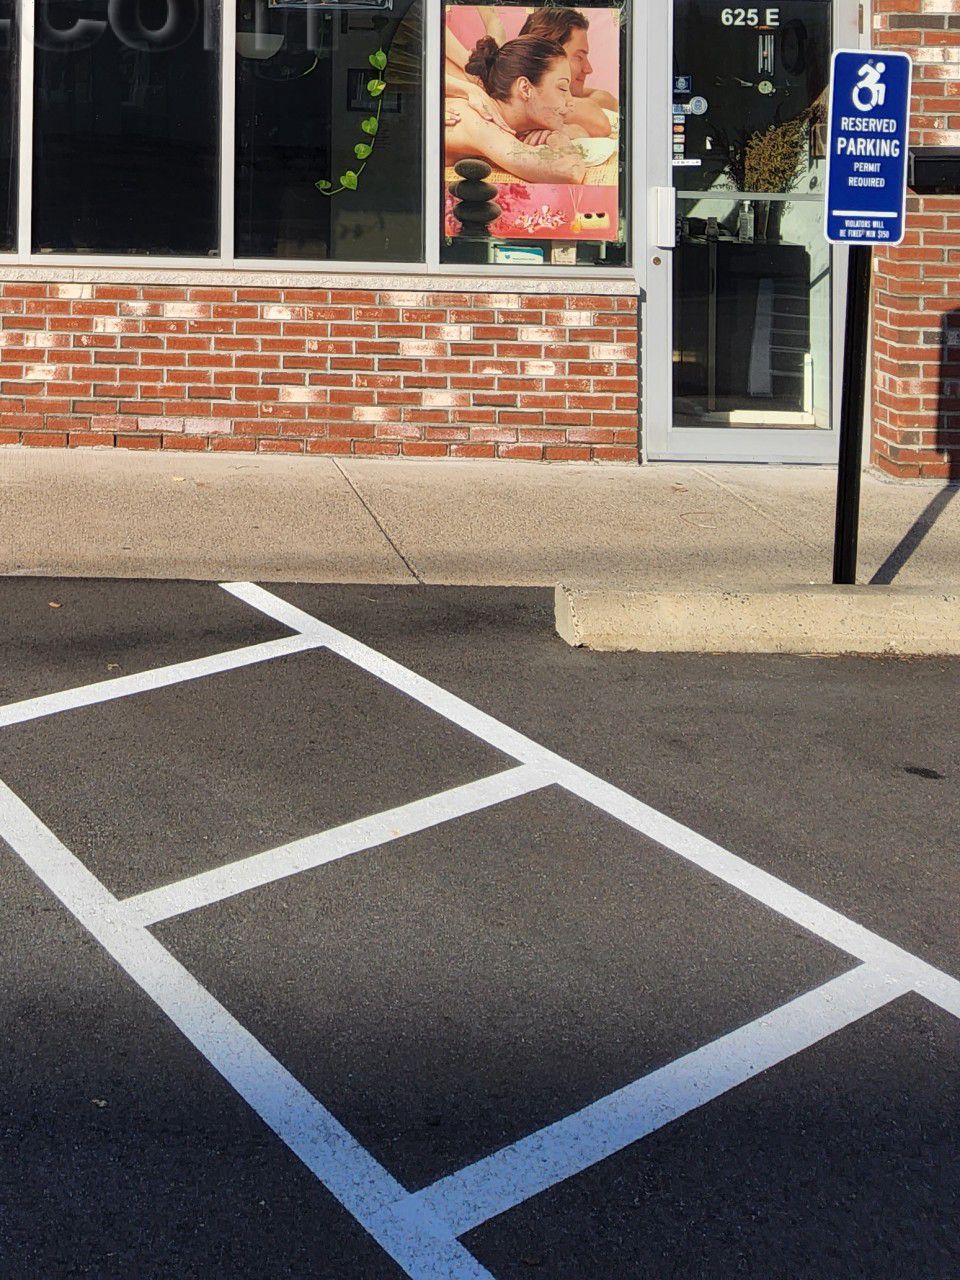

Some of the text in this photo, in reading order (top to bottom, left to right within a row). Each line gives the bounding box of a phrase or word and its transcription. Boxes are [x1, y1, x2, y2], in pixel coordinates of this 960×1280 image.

[721, 8, 780, 26] 625 E
[841, 117, 897, 133] RESERVED
[837, 137, 900, 157] PARKING
[853, 162, 881, 173] PERMIT
[848, 176, 886, 188] REQUIRED
